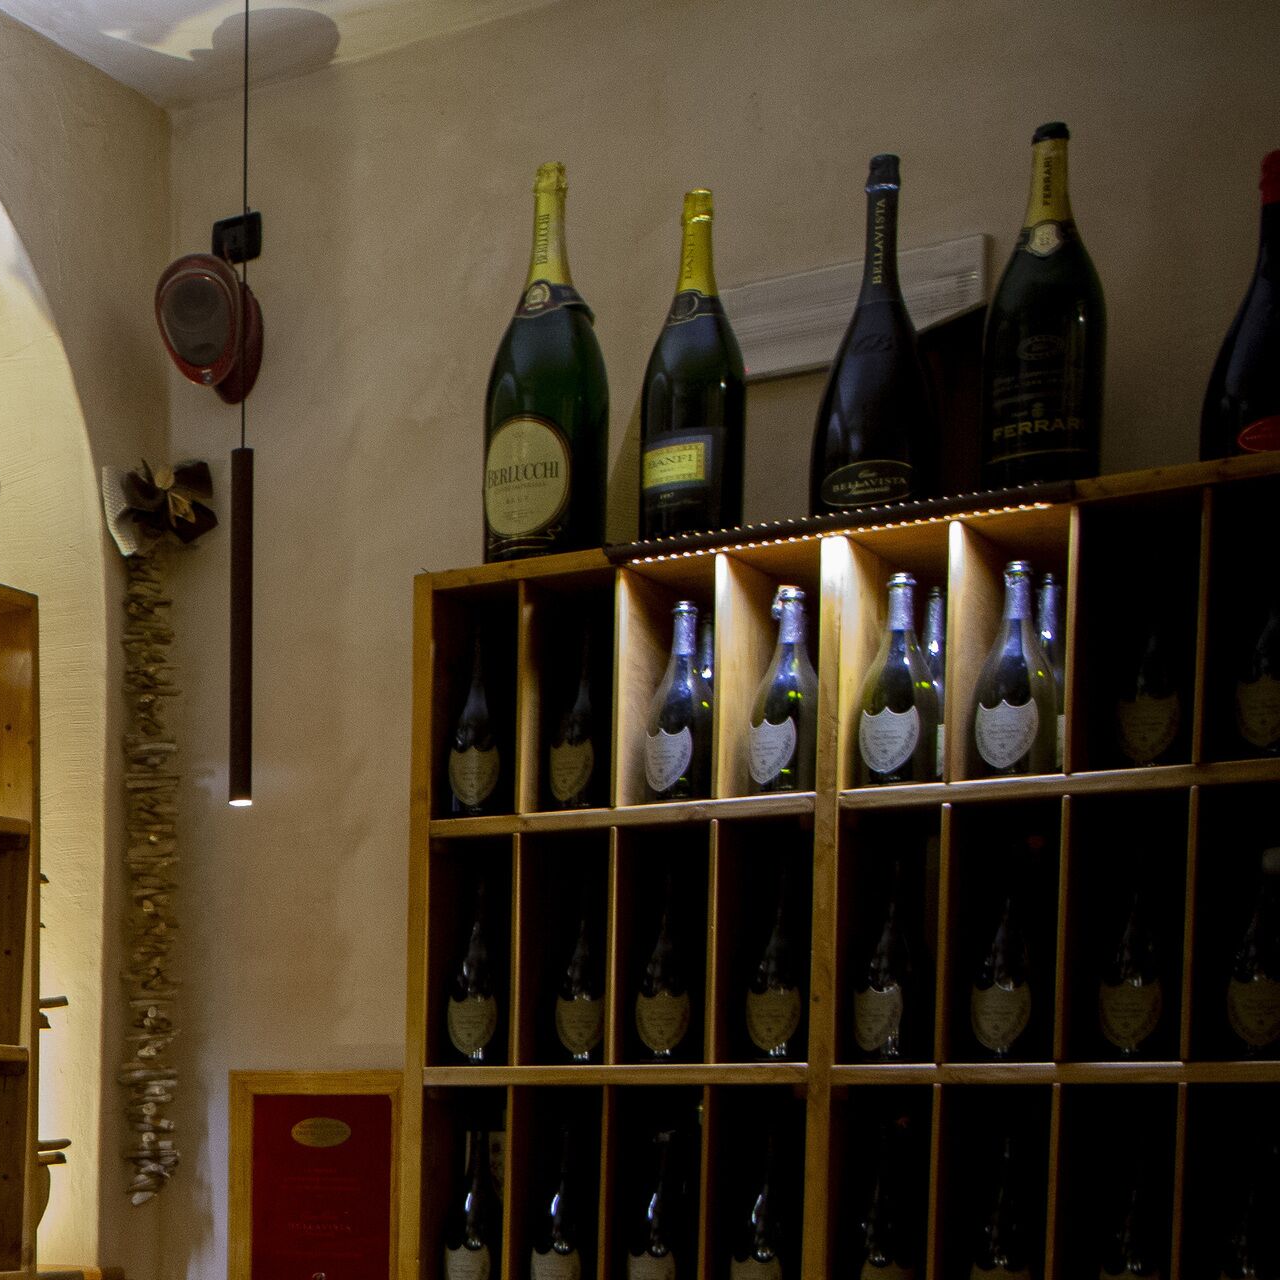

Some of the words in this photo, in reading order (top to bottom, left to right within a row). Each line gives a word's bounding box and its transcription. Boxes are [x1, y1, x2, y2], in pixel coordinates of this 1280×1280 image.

[1042, 156, 1053, 207] FERRARI
[871, 198, 886, 285] BELLAVISTA
[487, 462, 559, 488] BERLUCCHI
[831, 476, 907, 493] BELLAVISTA
